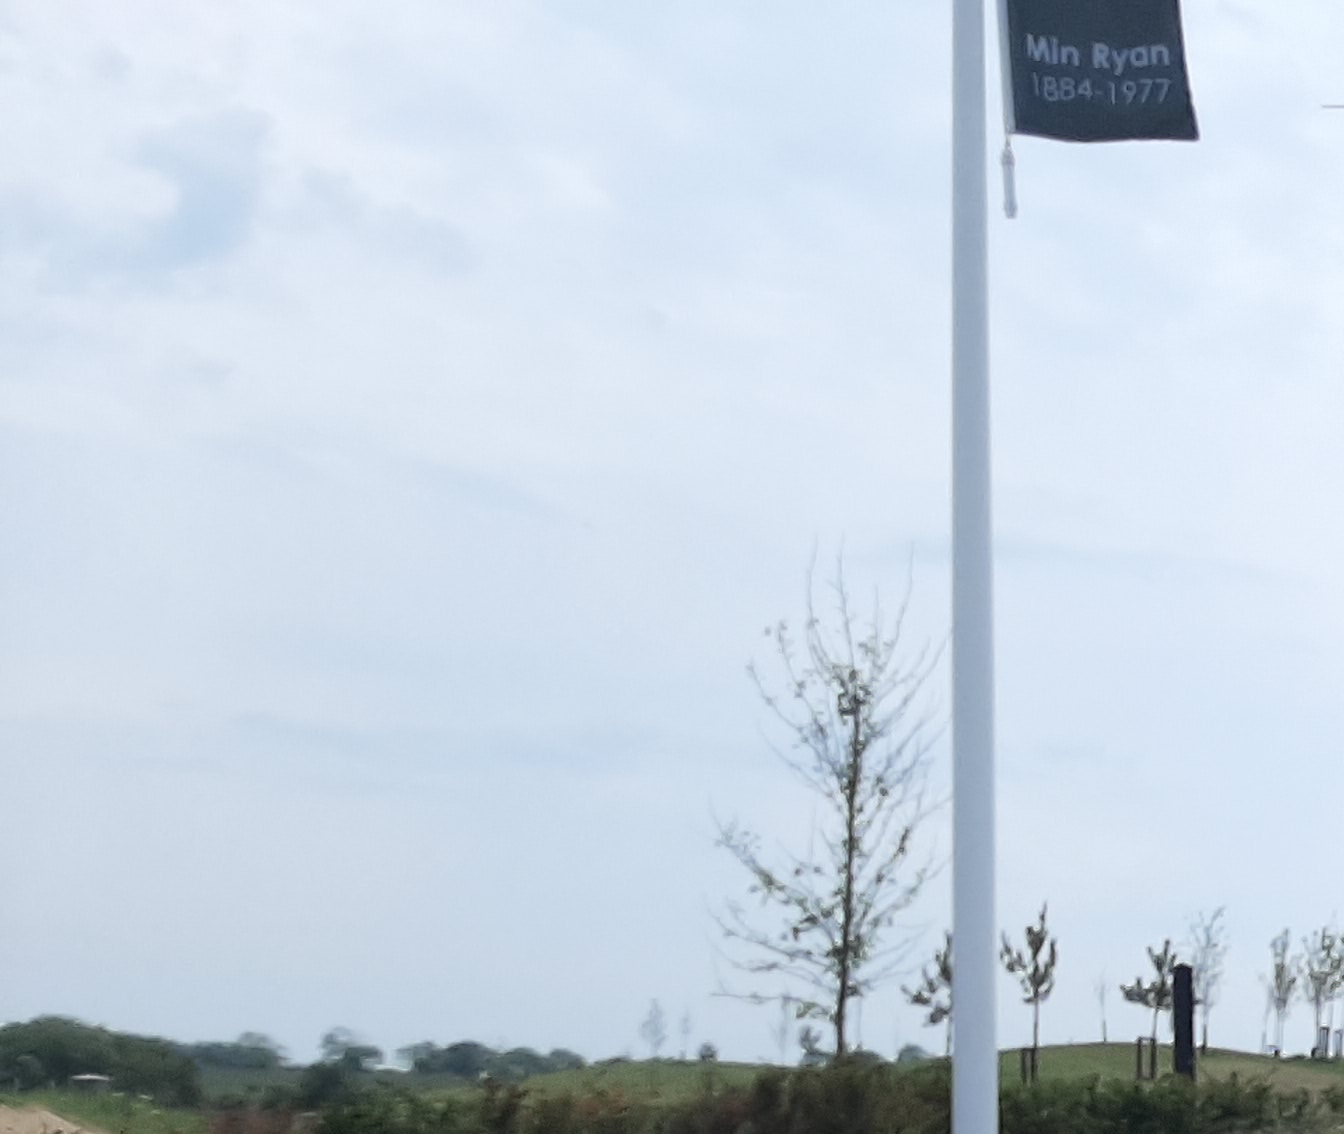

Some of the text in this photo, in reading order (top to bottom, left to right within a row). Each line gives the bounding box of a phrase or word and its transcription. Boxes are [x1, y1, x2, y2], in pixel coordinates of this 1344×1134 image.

[1026, 33, 1170, 77] Min Ryan
[1032, 72, 1171, 105] 1884-1977
